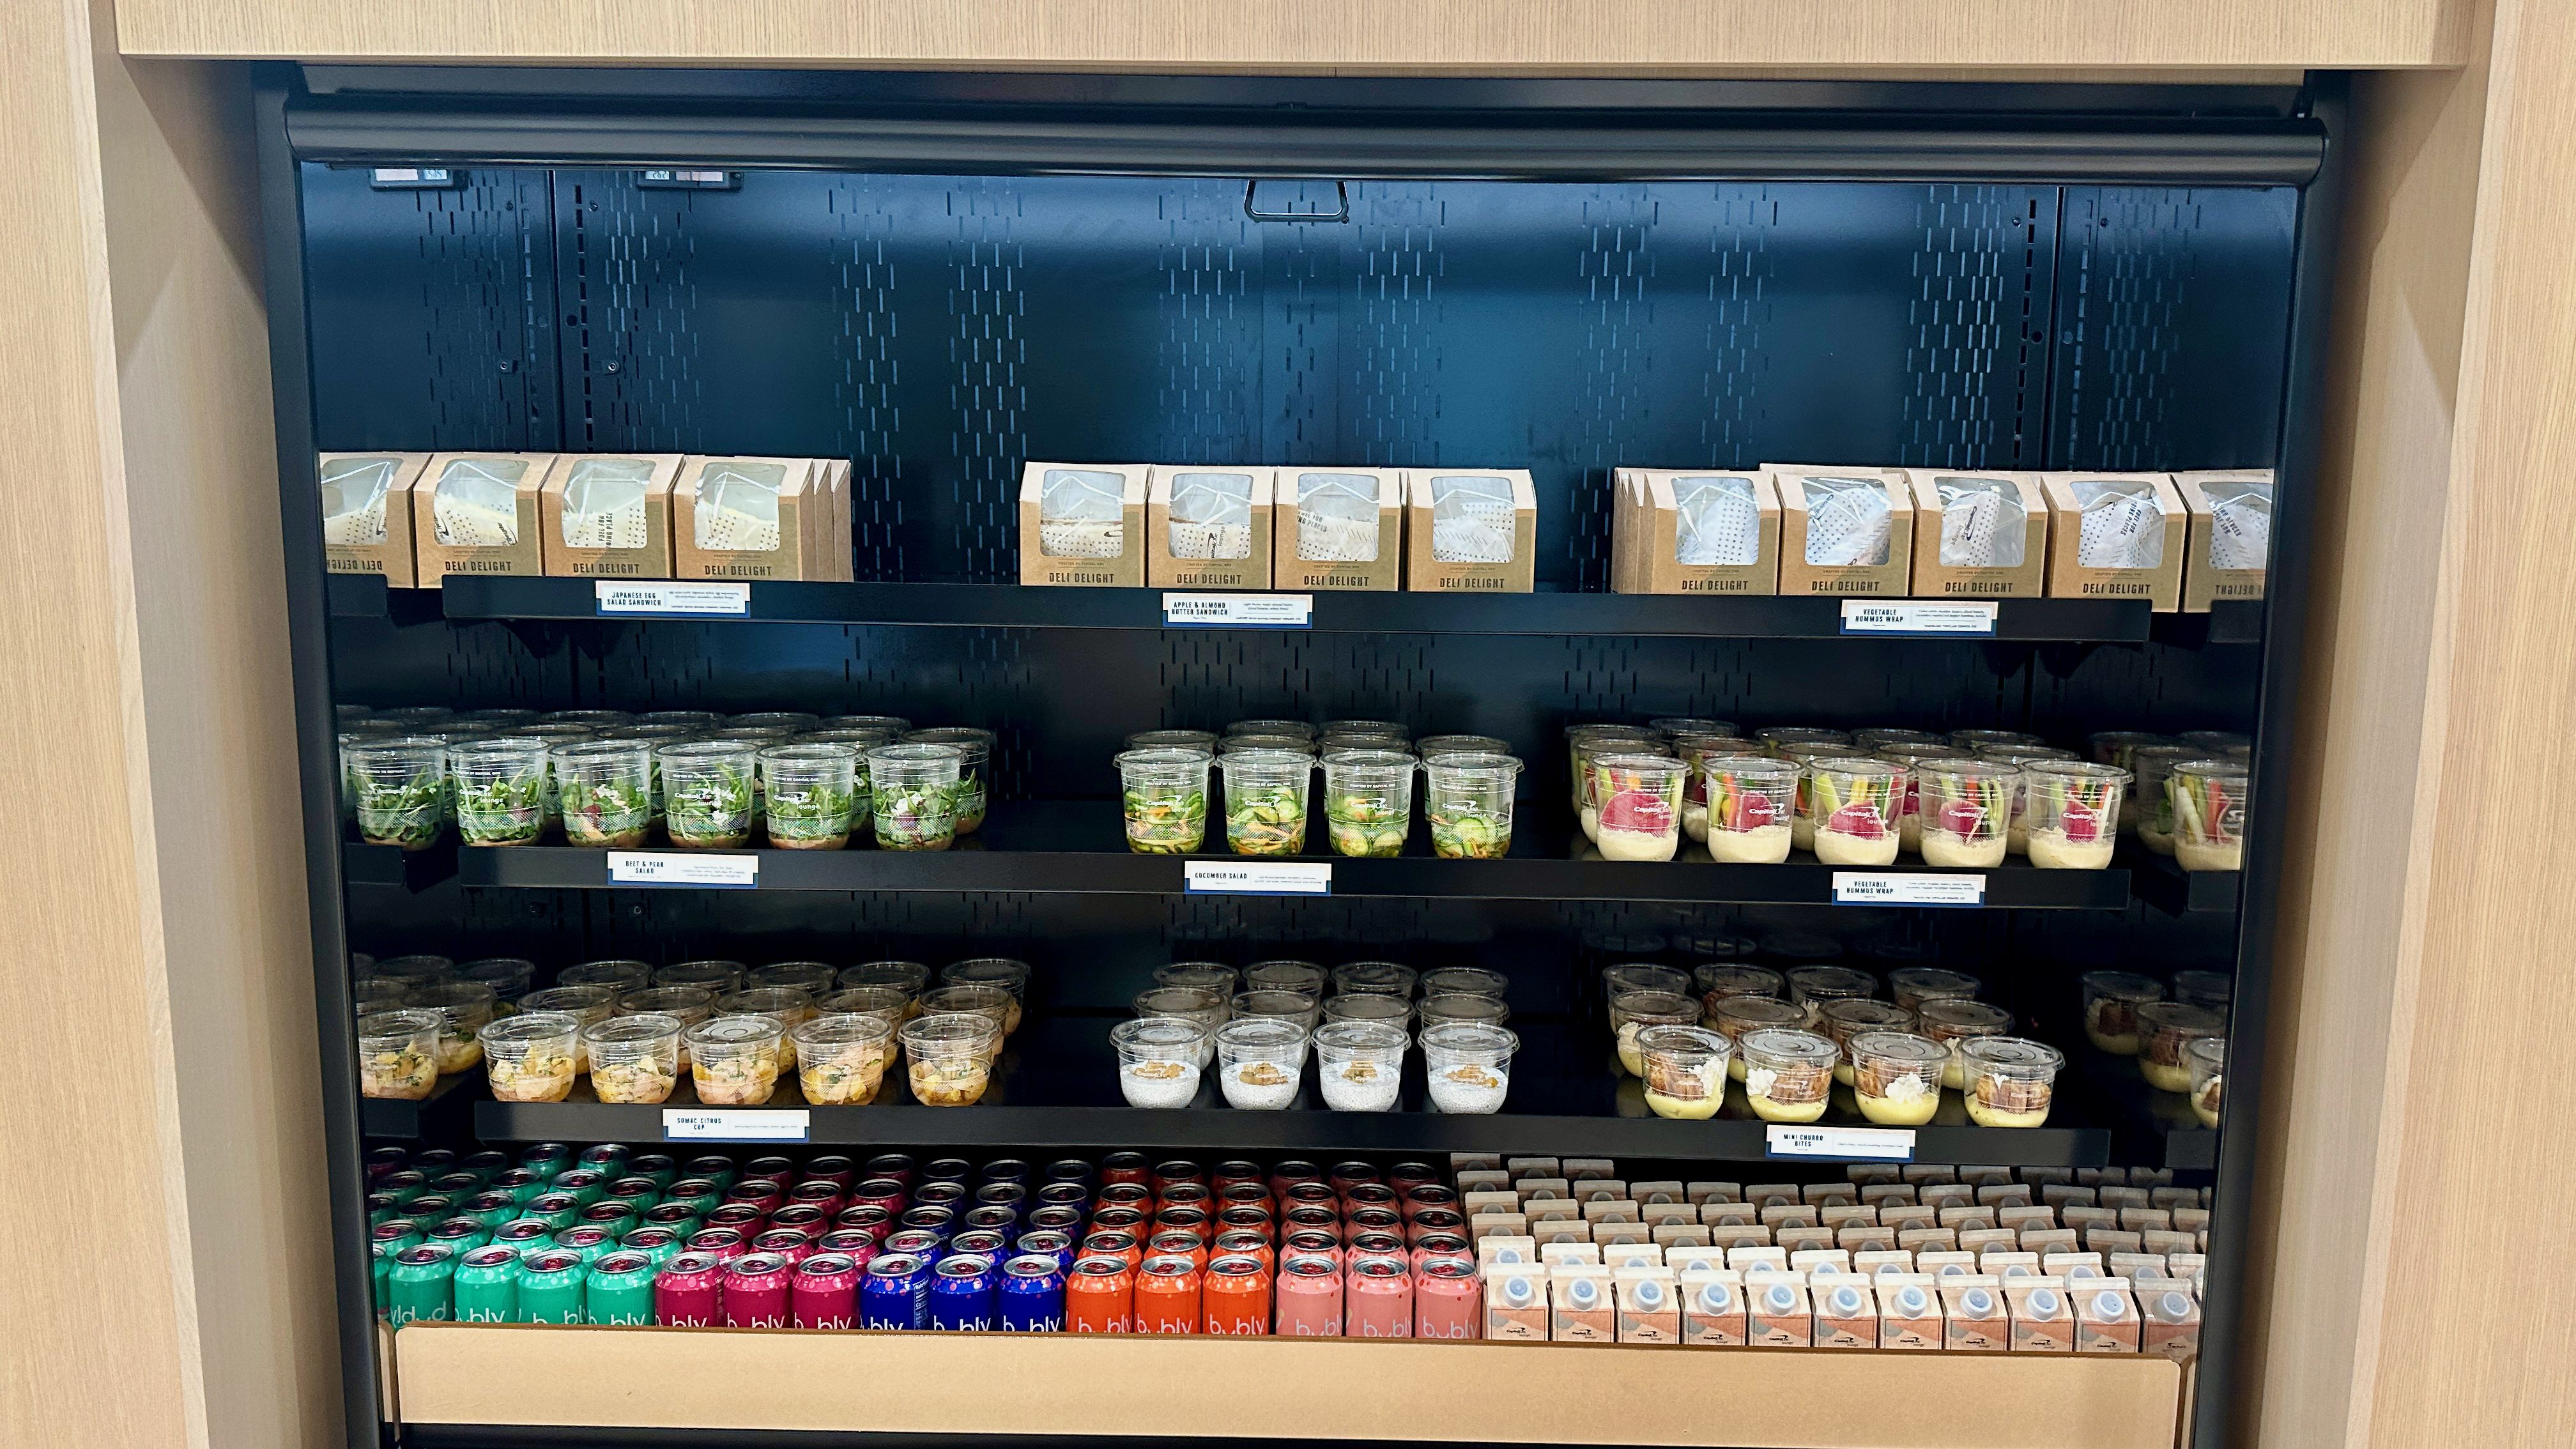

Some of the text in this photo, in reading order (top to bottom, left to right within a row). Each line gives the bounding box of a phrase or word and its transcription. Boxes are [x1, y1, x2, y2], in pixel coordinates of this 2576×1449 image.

[445, 561, 512, 571] DELI DELIGHT
[572, 563, 640, 574] DELI DELIGHT
[705, 565, 772, 576] DELI DELIGHT
[1049, 572, 1114, 583] DELI DELIGHT
[1177, 574, 1241, 585] DELI DELIGHT
[1304, 575, 1369, 586] DELI DELIGHT
[1439, 578, 1505, 588] DELI DELIGHT
[1682, 580, 1748, 590] DELI DELIGHT
[1811, 581, 1880, 592] DELI DELIGHT
[1945, 582, 2012, 593] DELI DELIGHT
[2083, 583, 2150, 595] DELI DELIGHT
